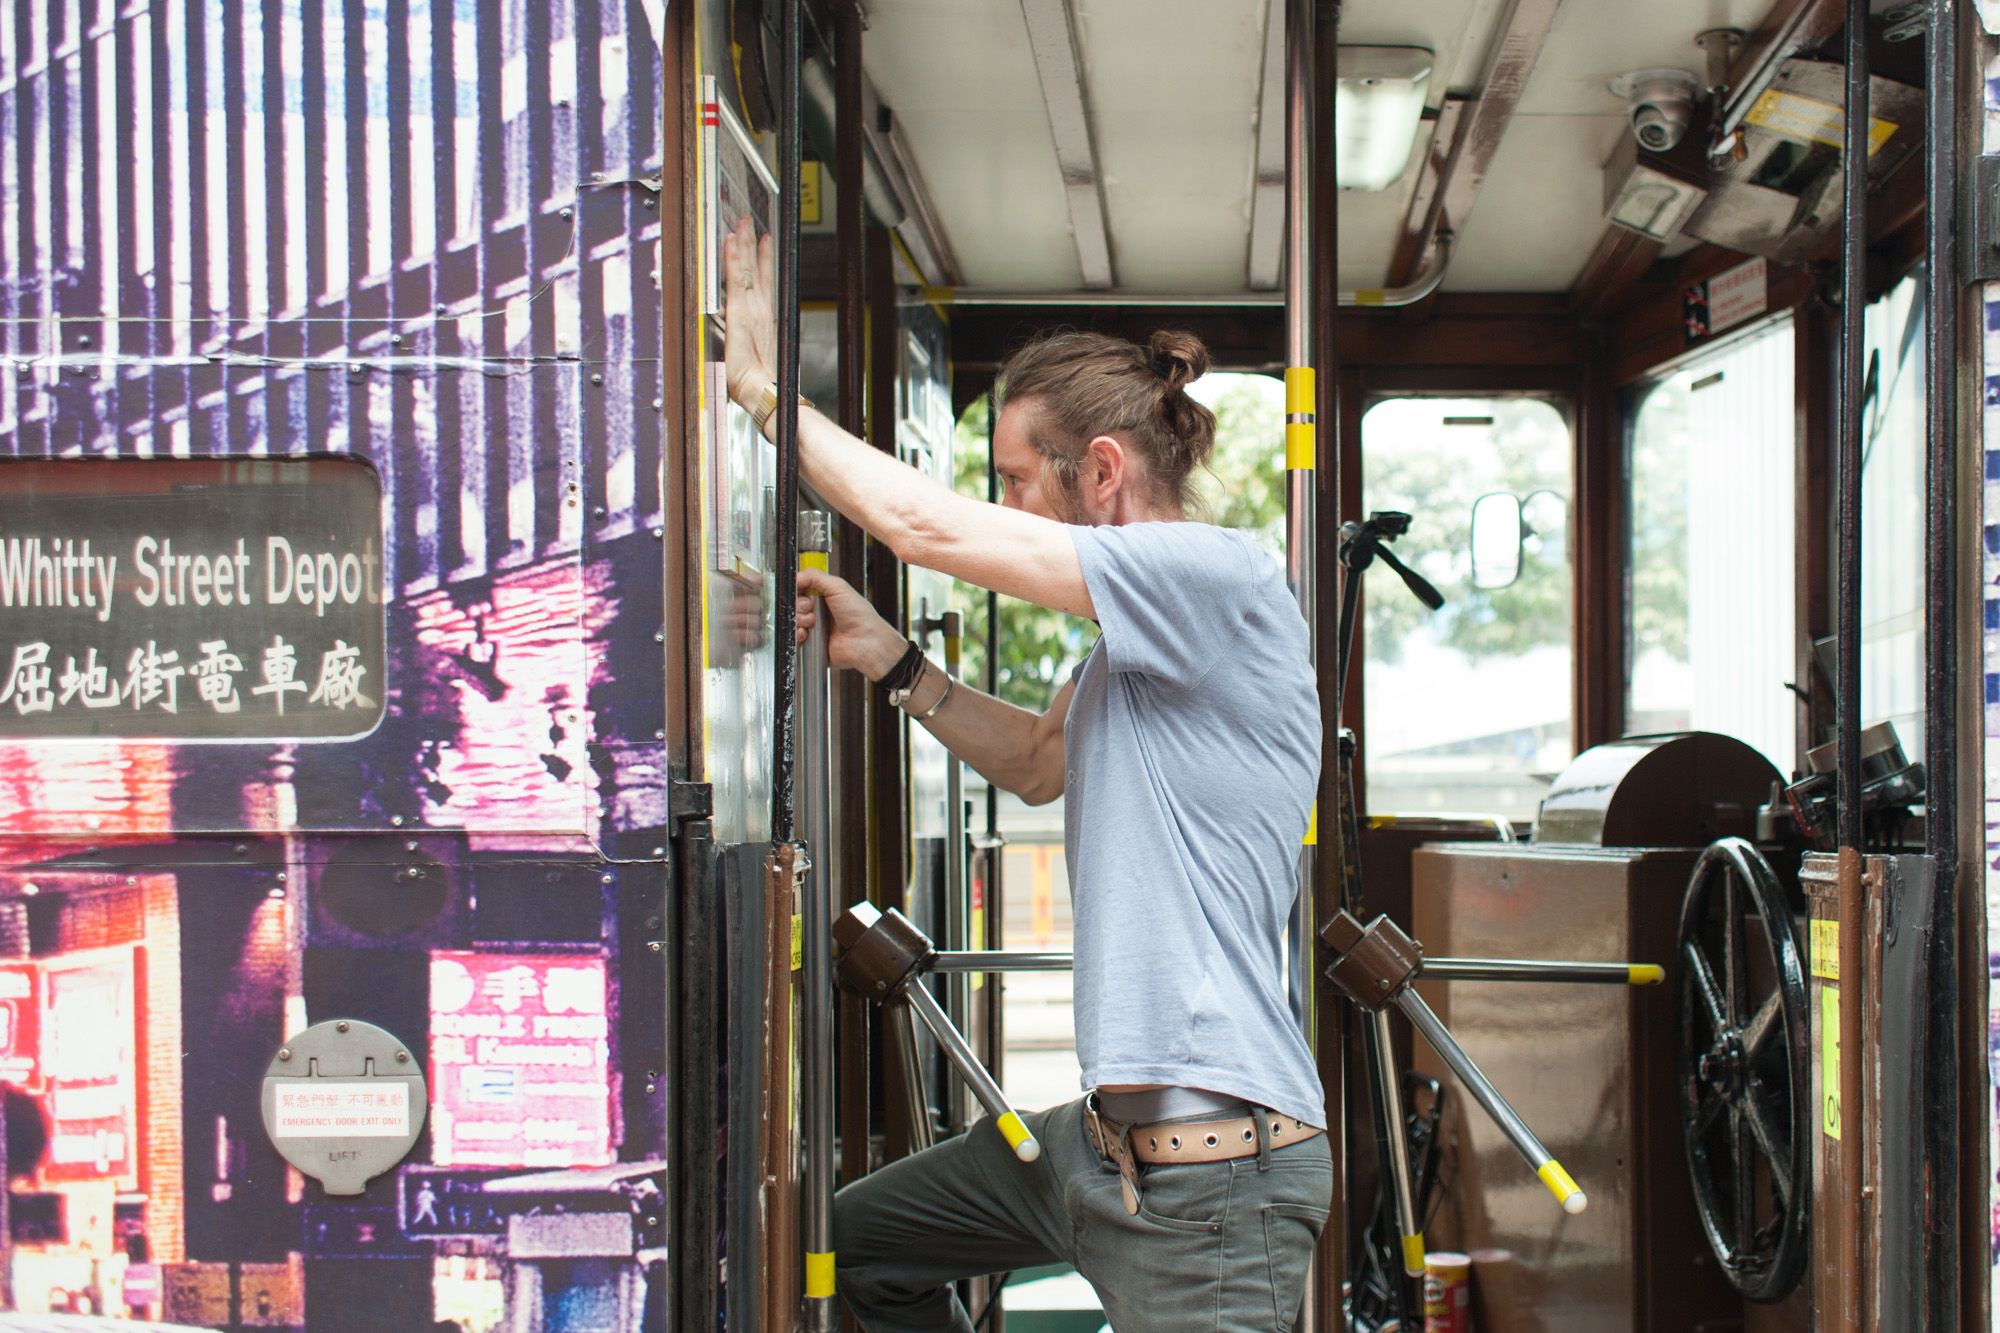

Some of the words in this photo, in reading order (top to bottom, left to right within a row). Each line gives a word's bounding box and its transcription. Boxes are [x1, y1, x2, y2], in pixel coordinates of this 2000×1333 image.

[0, 537, 117, 621] Whitty
[134, 535, 251, 608] Street
[265, 536, 382, 616] Depot
[0, 634, 378, 717] 屈地街電車廠
[282, 1117, 332, 1126] EMERGENCY
[335, 1116, 358, 1126] DOOR
[361, 1116, 379, 1126] EXIT
[382, 1116, 402, 1126] ONLY
